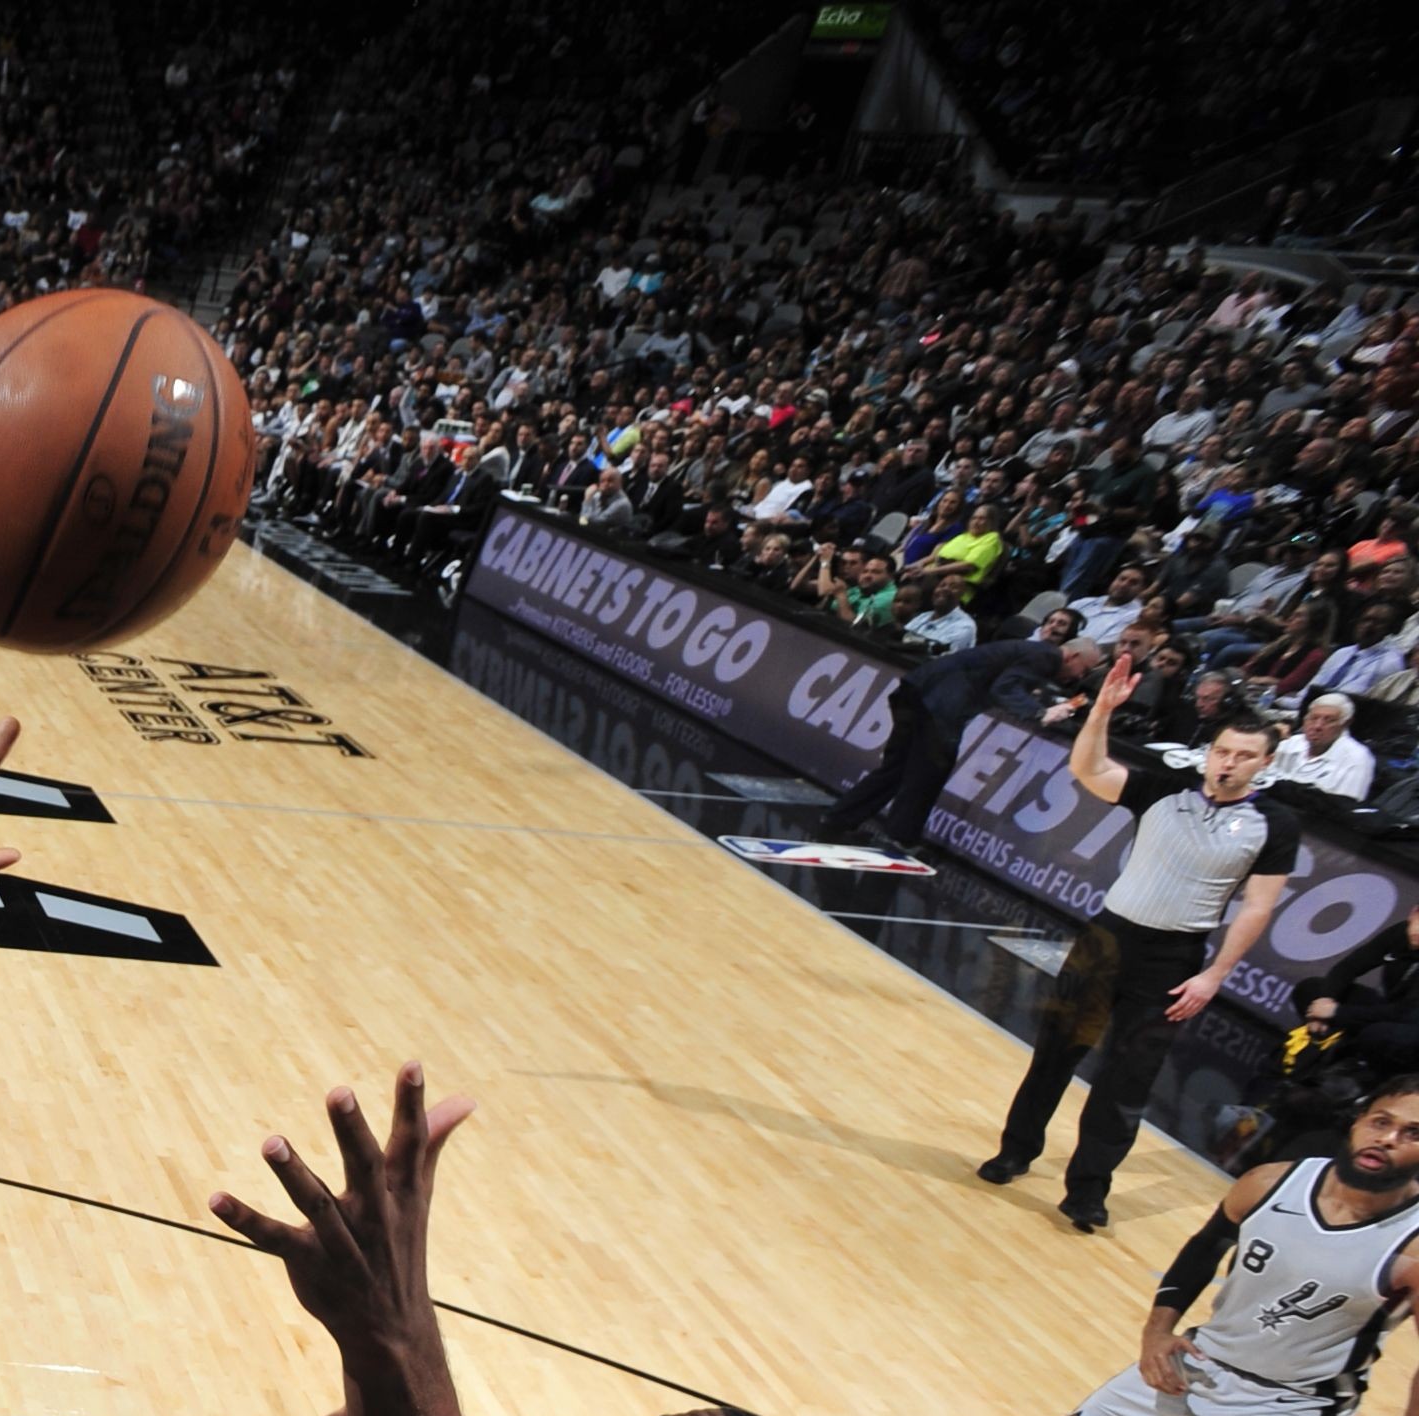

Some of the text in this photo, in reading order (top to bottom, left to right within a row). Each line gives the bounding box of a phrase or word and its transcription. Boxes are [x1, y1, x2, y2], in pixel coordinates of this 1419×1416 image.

[480, 515, 647, 625] CABINETS
[625, 571, 700, 649] TO
[682, 605, 771, 682] GO
[68, 651, 221, 745] CENTER
[550, 612, 598, 651] KITCHENS
[593, 640, 615, 661] and
[612, 644, 656, 682] FLOORS
[662, 672, 688, 700] FOR
[150, 654, 377, 760] AT&T
[927, 809, 1022, 871] KITCHENS
[1008, 855, 1047, 890] and
[1242, 1238, 1277, 1274] 8
